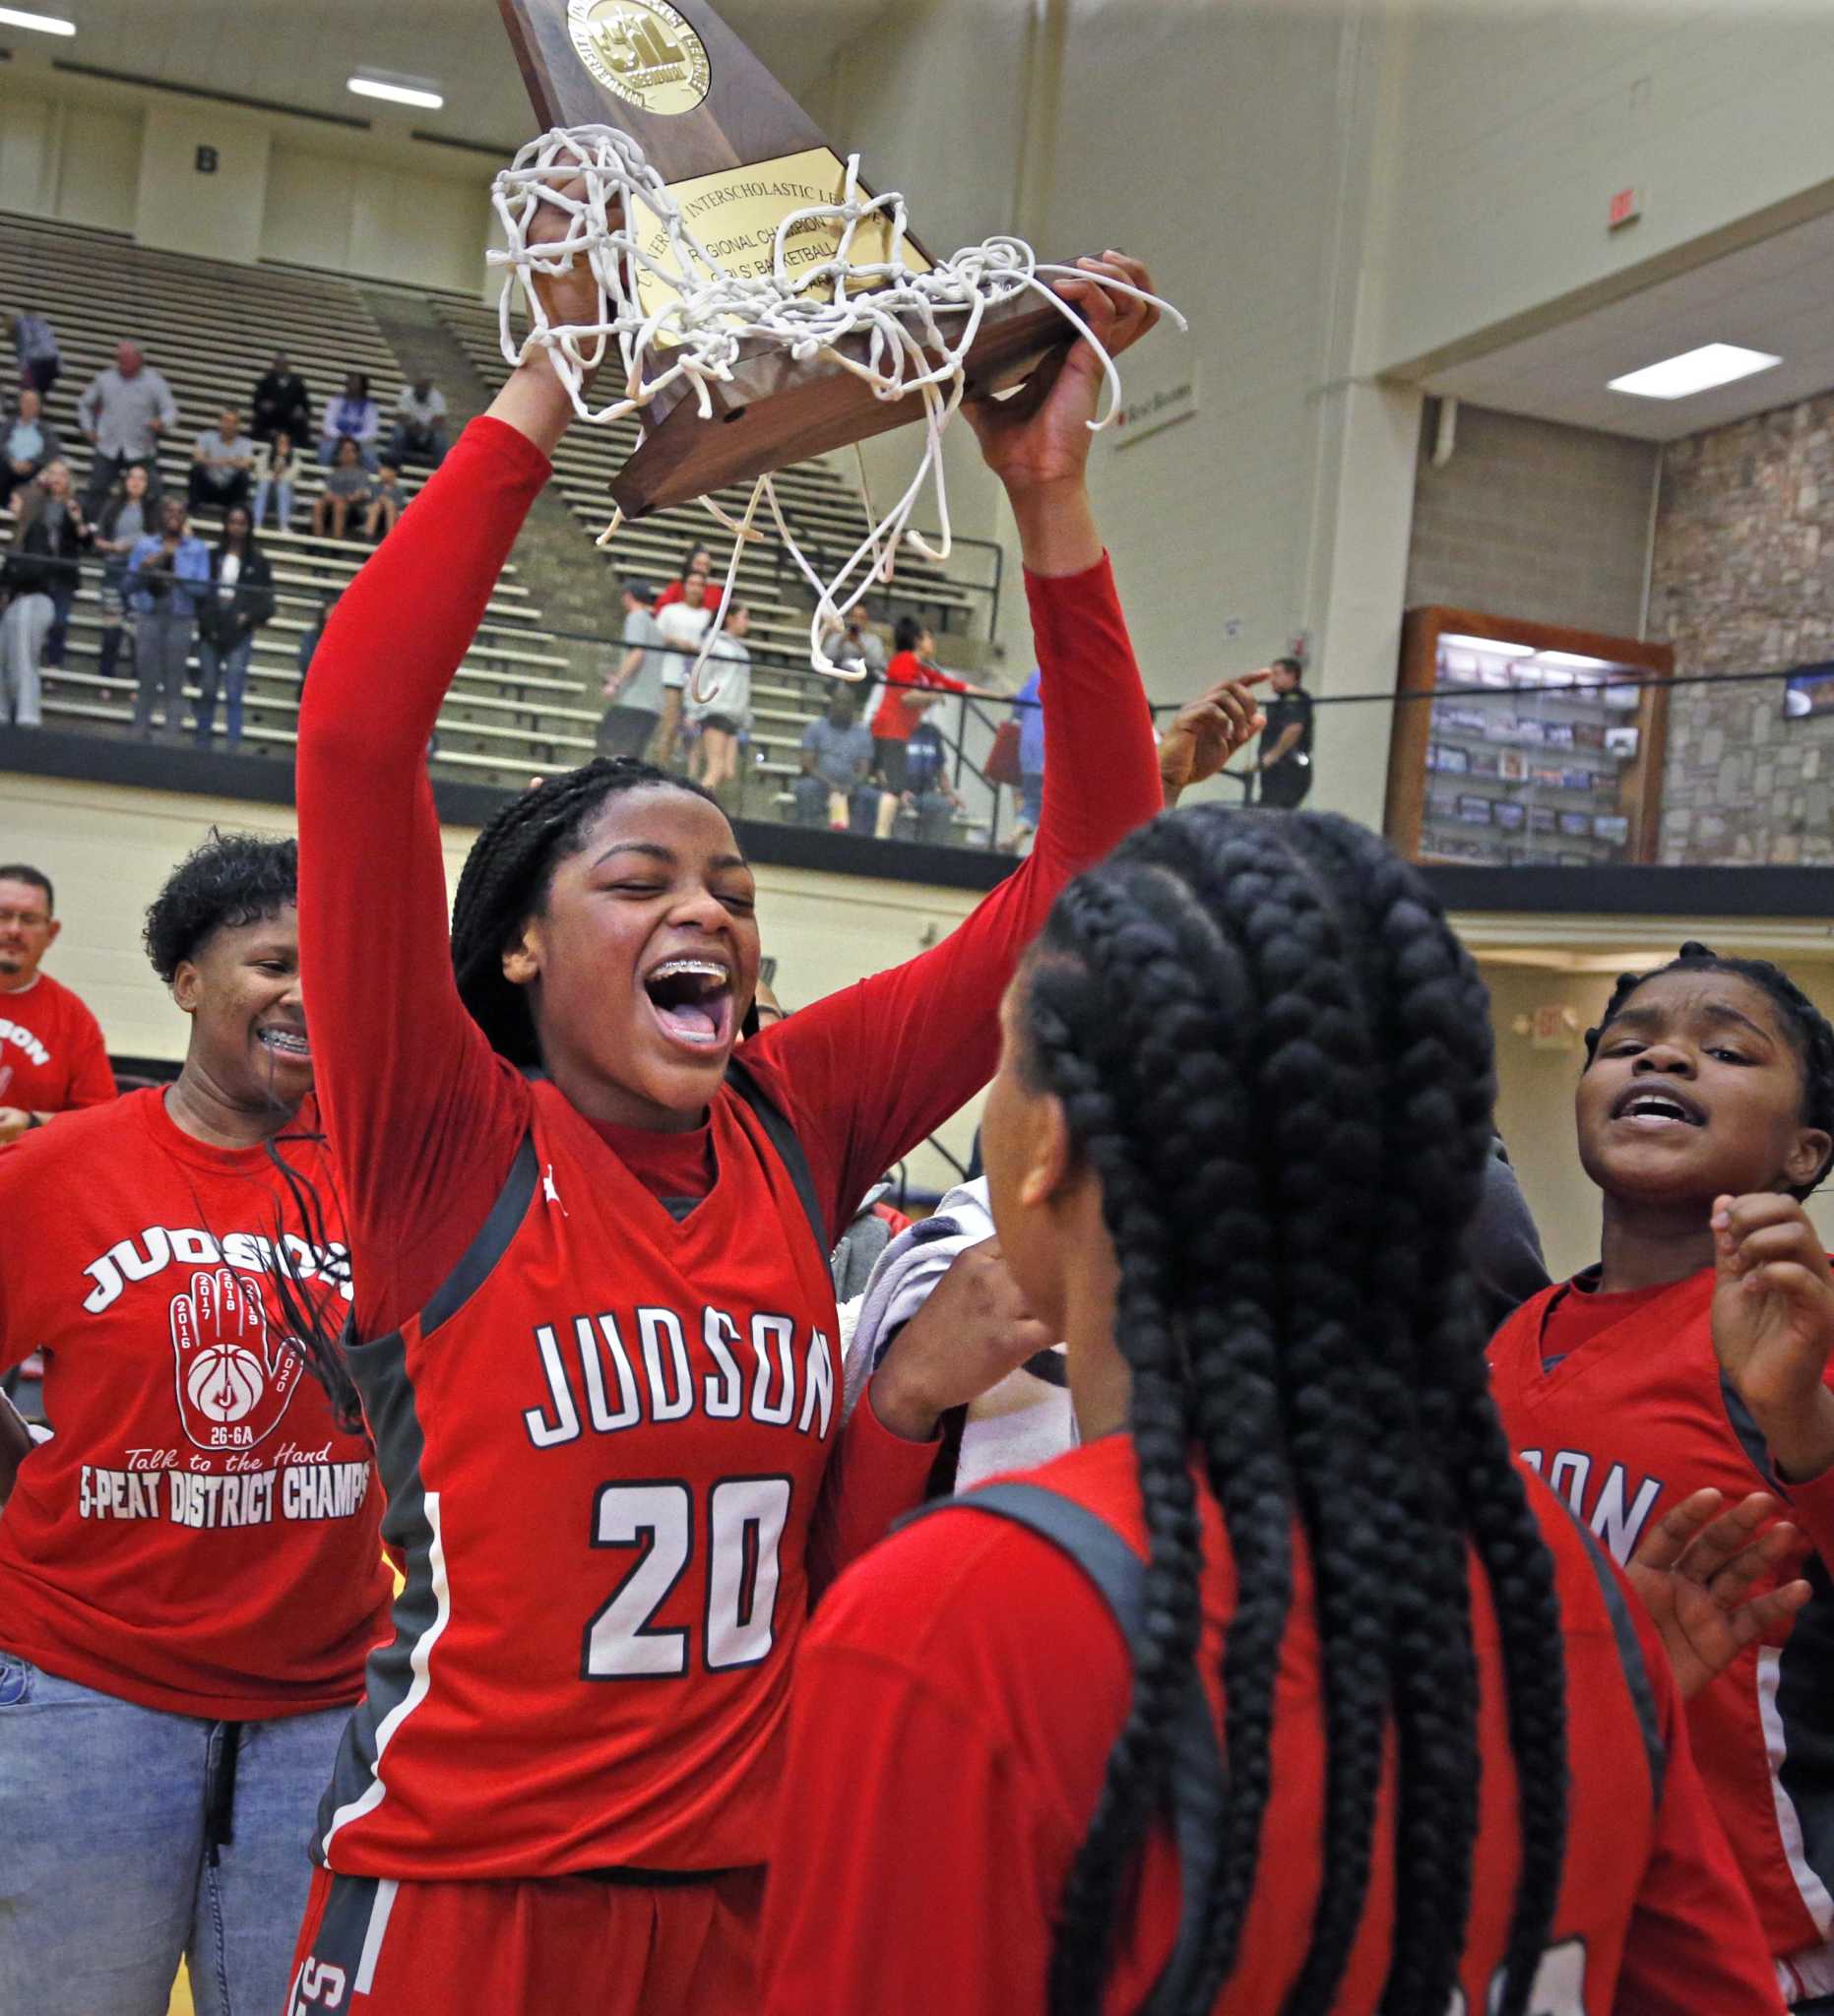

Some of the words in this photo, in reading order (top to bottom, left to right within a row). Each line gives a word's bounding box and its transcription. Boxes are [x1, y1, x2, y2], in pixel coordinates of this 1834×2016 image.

[685, 180, 815, 219] INTERSCHOLASTIC
[687, 232, 758, 263] RGIONAL
[754, 242, 837, 275] BAKETBALL
[199, 1276, 212, 1320] 2017
[222, 1272, 236, 1311] 2018
[176, 1300, 191, 1349] 2016
[522, 1305, 837, 1449] JUDSON
[211, 1425, 254, 1445] 26-6A
[125, 1449, 178, 1472] Talk
[189, 1454, 212, 1472] to
[225, 1452, 263, 1472] the
[274, 1442, 332, 1466] Hand
[79, 1464, 161, 1520] 5-PEAT
[167, 1469, 278, 1529] DISTRICT
[580, 1473, 793, 1679] 20
